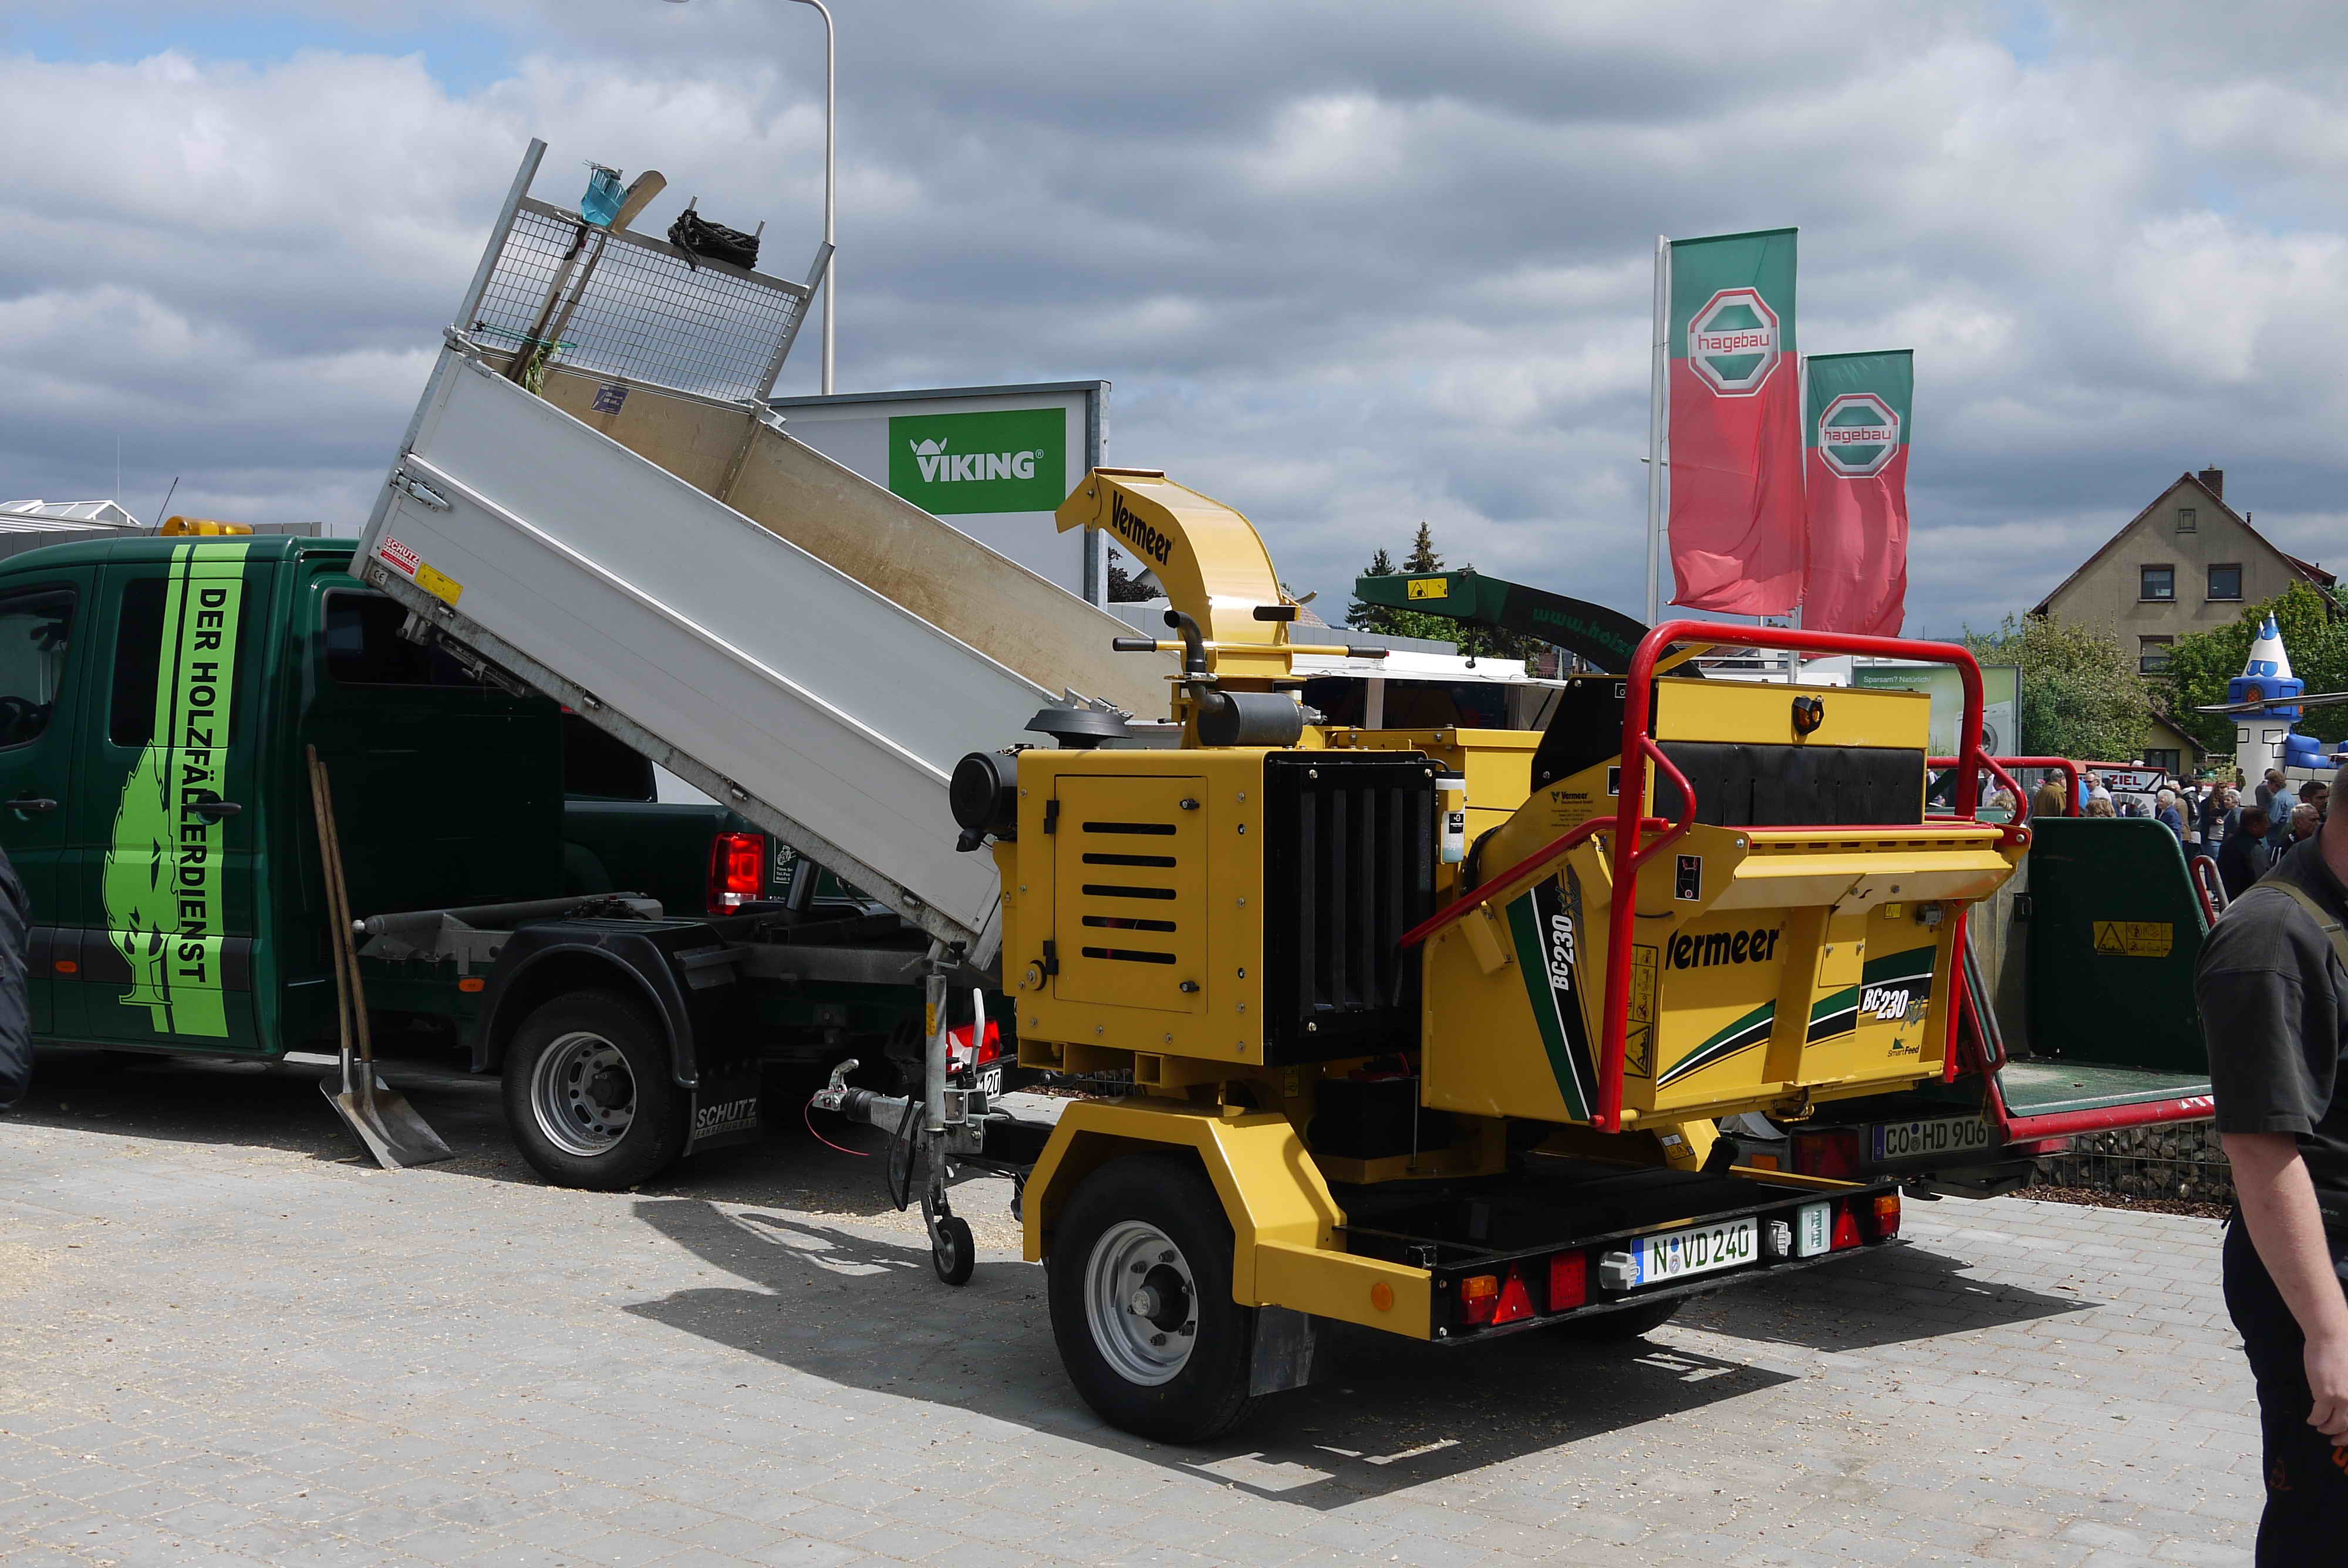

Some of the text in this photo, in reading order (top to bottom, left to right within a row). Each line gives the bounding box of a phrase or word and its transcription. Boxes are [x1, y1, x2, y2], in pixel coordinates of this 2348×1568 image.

[1698, 332, 1769, 352] hagebau
[1824, 428, 1891, 443] hagebau
[1112, 489, 1172, 566] Vermeer
[385, 538, 419, 563] SCHUTZ
[178, 589, 227, 982] DER HOLZFÄLLERDIENST
[1560, 791, 1588, 799] Vermeer
[2109, 775, 2141, 786] ZIEL
[1551, 914, 1574, 991] BC230
[1862, 988, 1909, 1019] BC230
[1887, 1045, 1920, 1057] SmartFeed
[697, 1097, 757, 1128] SCHUTZ
[1885, 1127, 1909, 1154] CO
[1922, 1123, 1948, 1150] HD
[1952, 1120, 1986, 1147] 906
[1654, 1239, 1667, 1275] N
[1682, 1233, 1708, 1269] VD
[1713, 1225, 1749, 1263] 240
